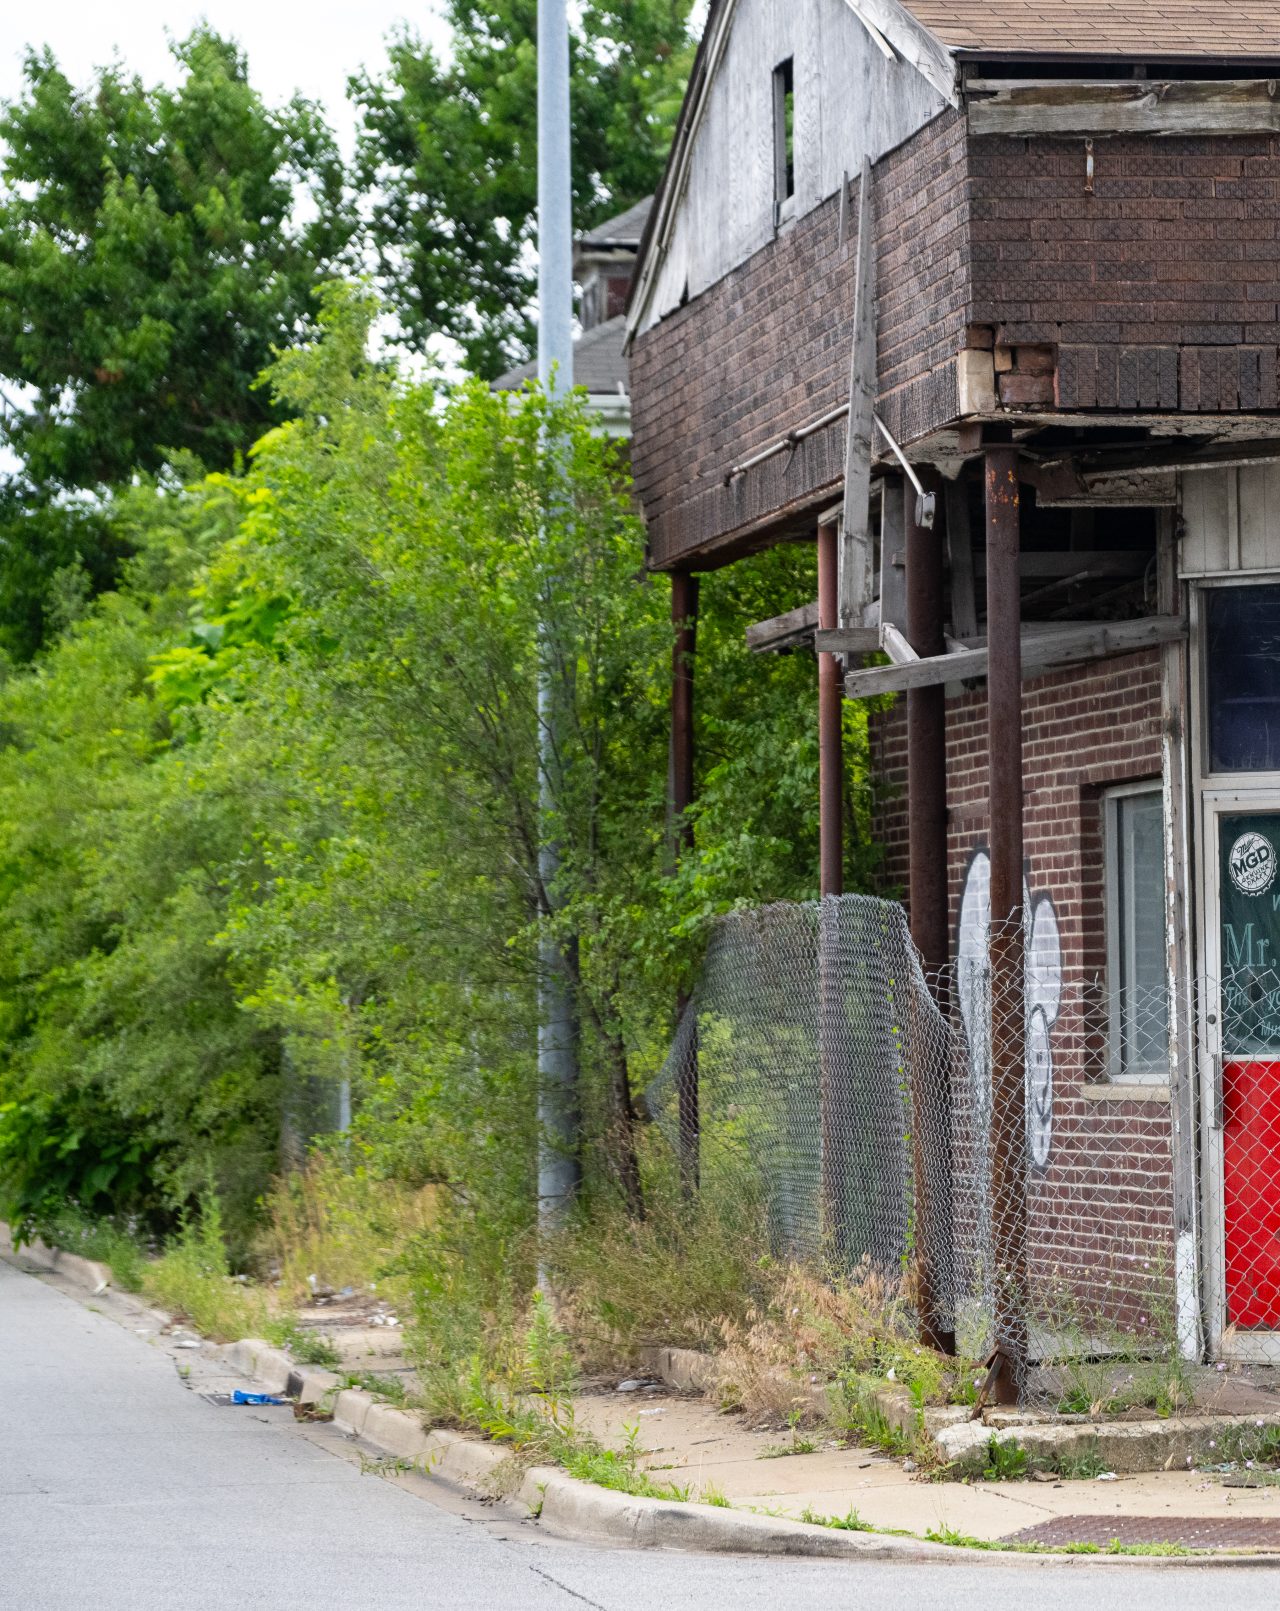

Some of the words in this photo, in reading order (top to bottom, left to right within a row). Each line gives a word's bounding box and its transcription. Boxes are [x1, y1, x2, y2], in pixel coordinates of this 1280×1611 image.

[1232, 845, 1270, 877] MGD
[1223, 922, 1277, 967] Mr.
[1226, 987, 1254, 1006] Tha
